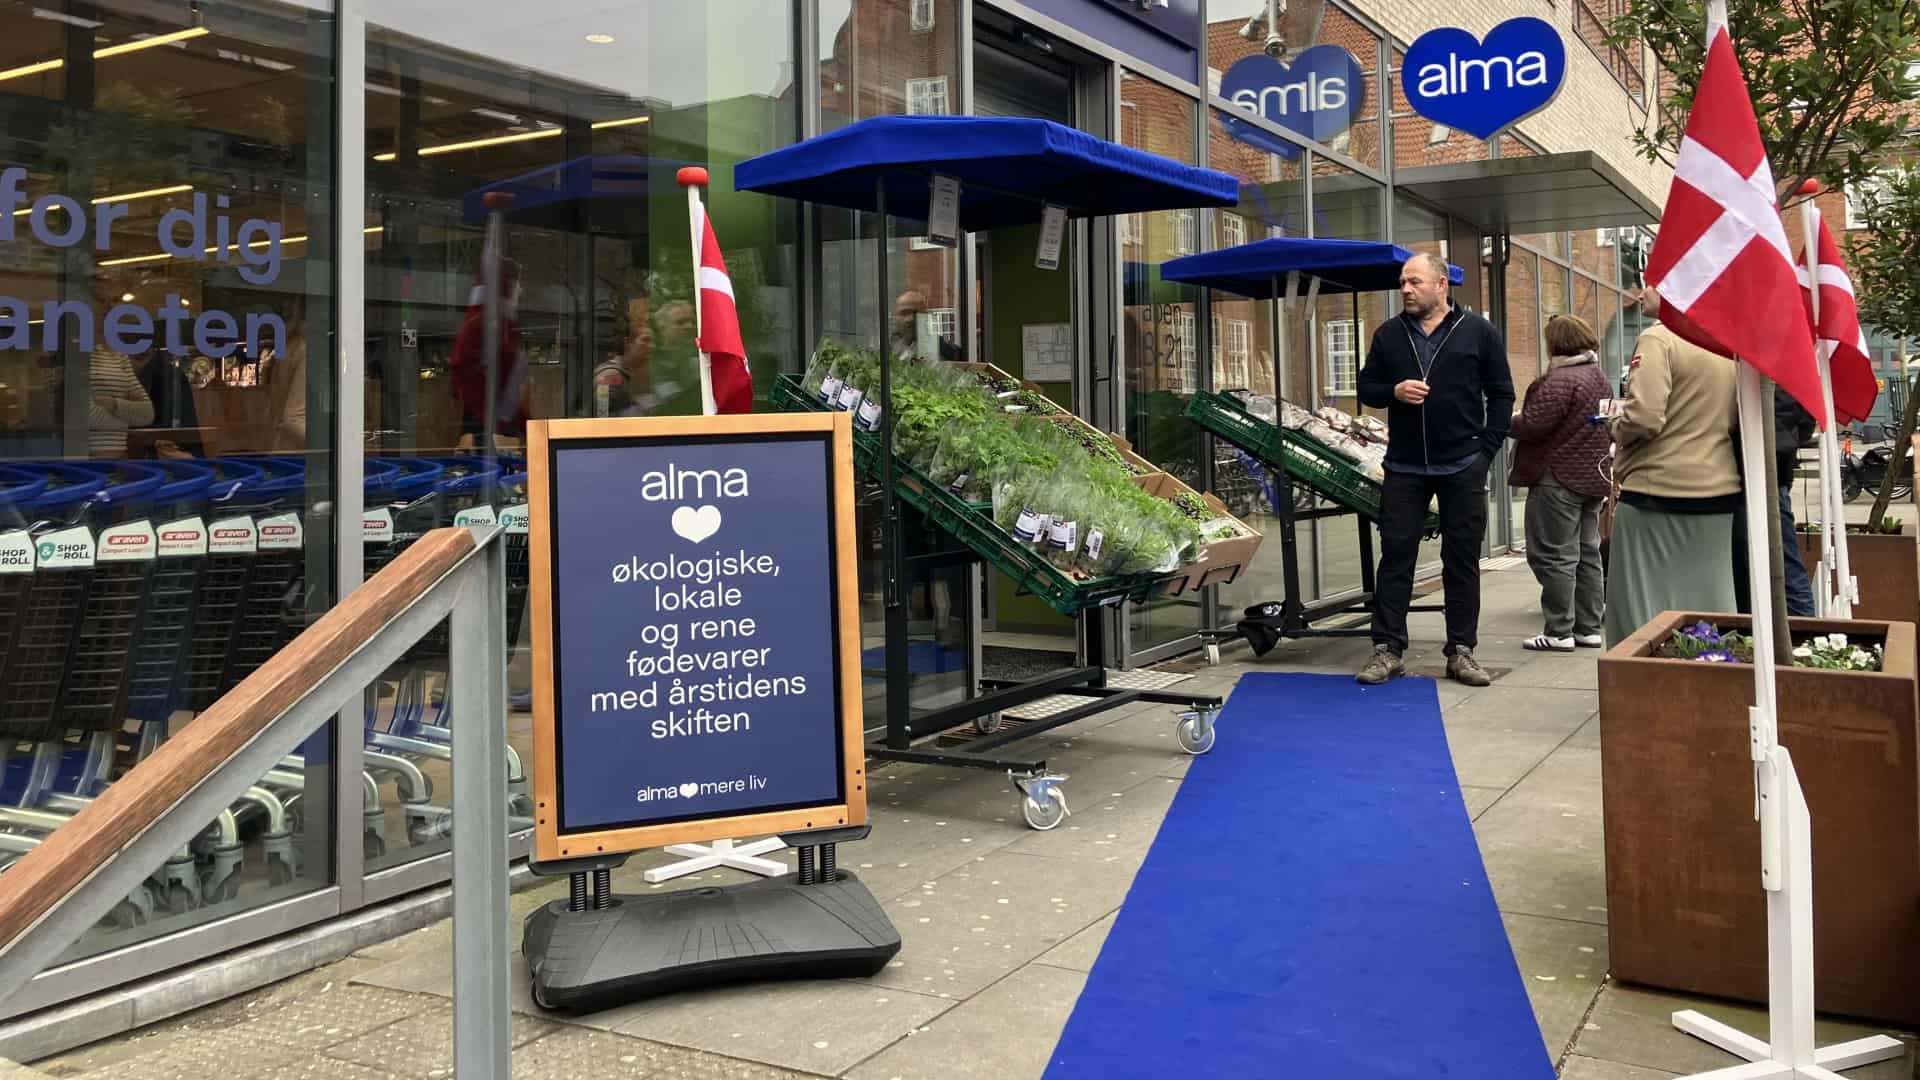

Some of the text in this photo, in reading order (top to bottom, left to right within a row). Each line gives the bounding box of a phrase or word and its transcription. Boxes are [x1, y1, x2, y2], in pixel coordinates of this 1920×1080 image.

[1418, 50, 1548, 98] alma
[0, 167, 281, 285] for dig
[0, 293, 287, 361] aneten
[641, 463, 749, 501] alma
[57, 544, 87, 552] SHOP
[111, 536, 145, 544] araven
[2, 557, 30, 565] ROLL
[612, 549, 780, 584] økologiske,
[655, 581, 742, 611] lokale
[641, 617, 756, 648] og rene
[626, 648, 771, 676] fødevarer
[591, 673, 806, 712] med årstidens
[651, 708, 750, 738] skiften
[637, 774, 767, 801] alma mere liv
